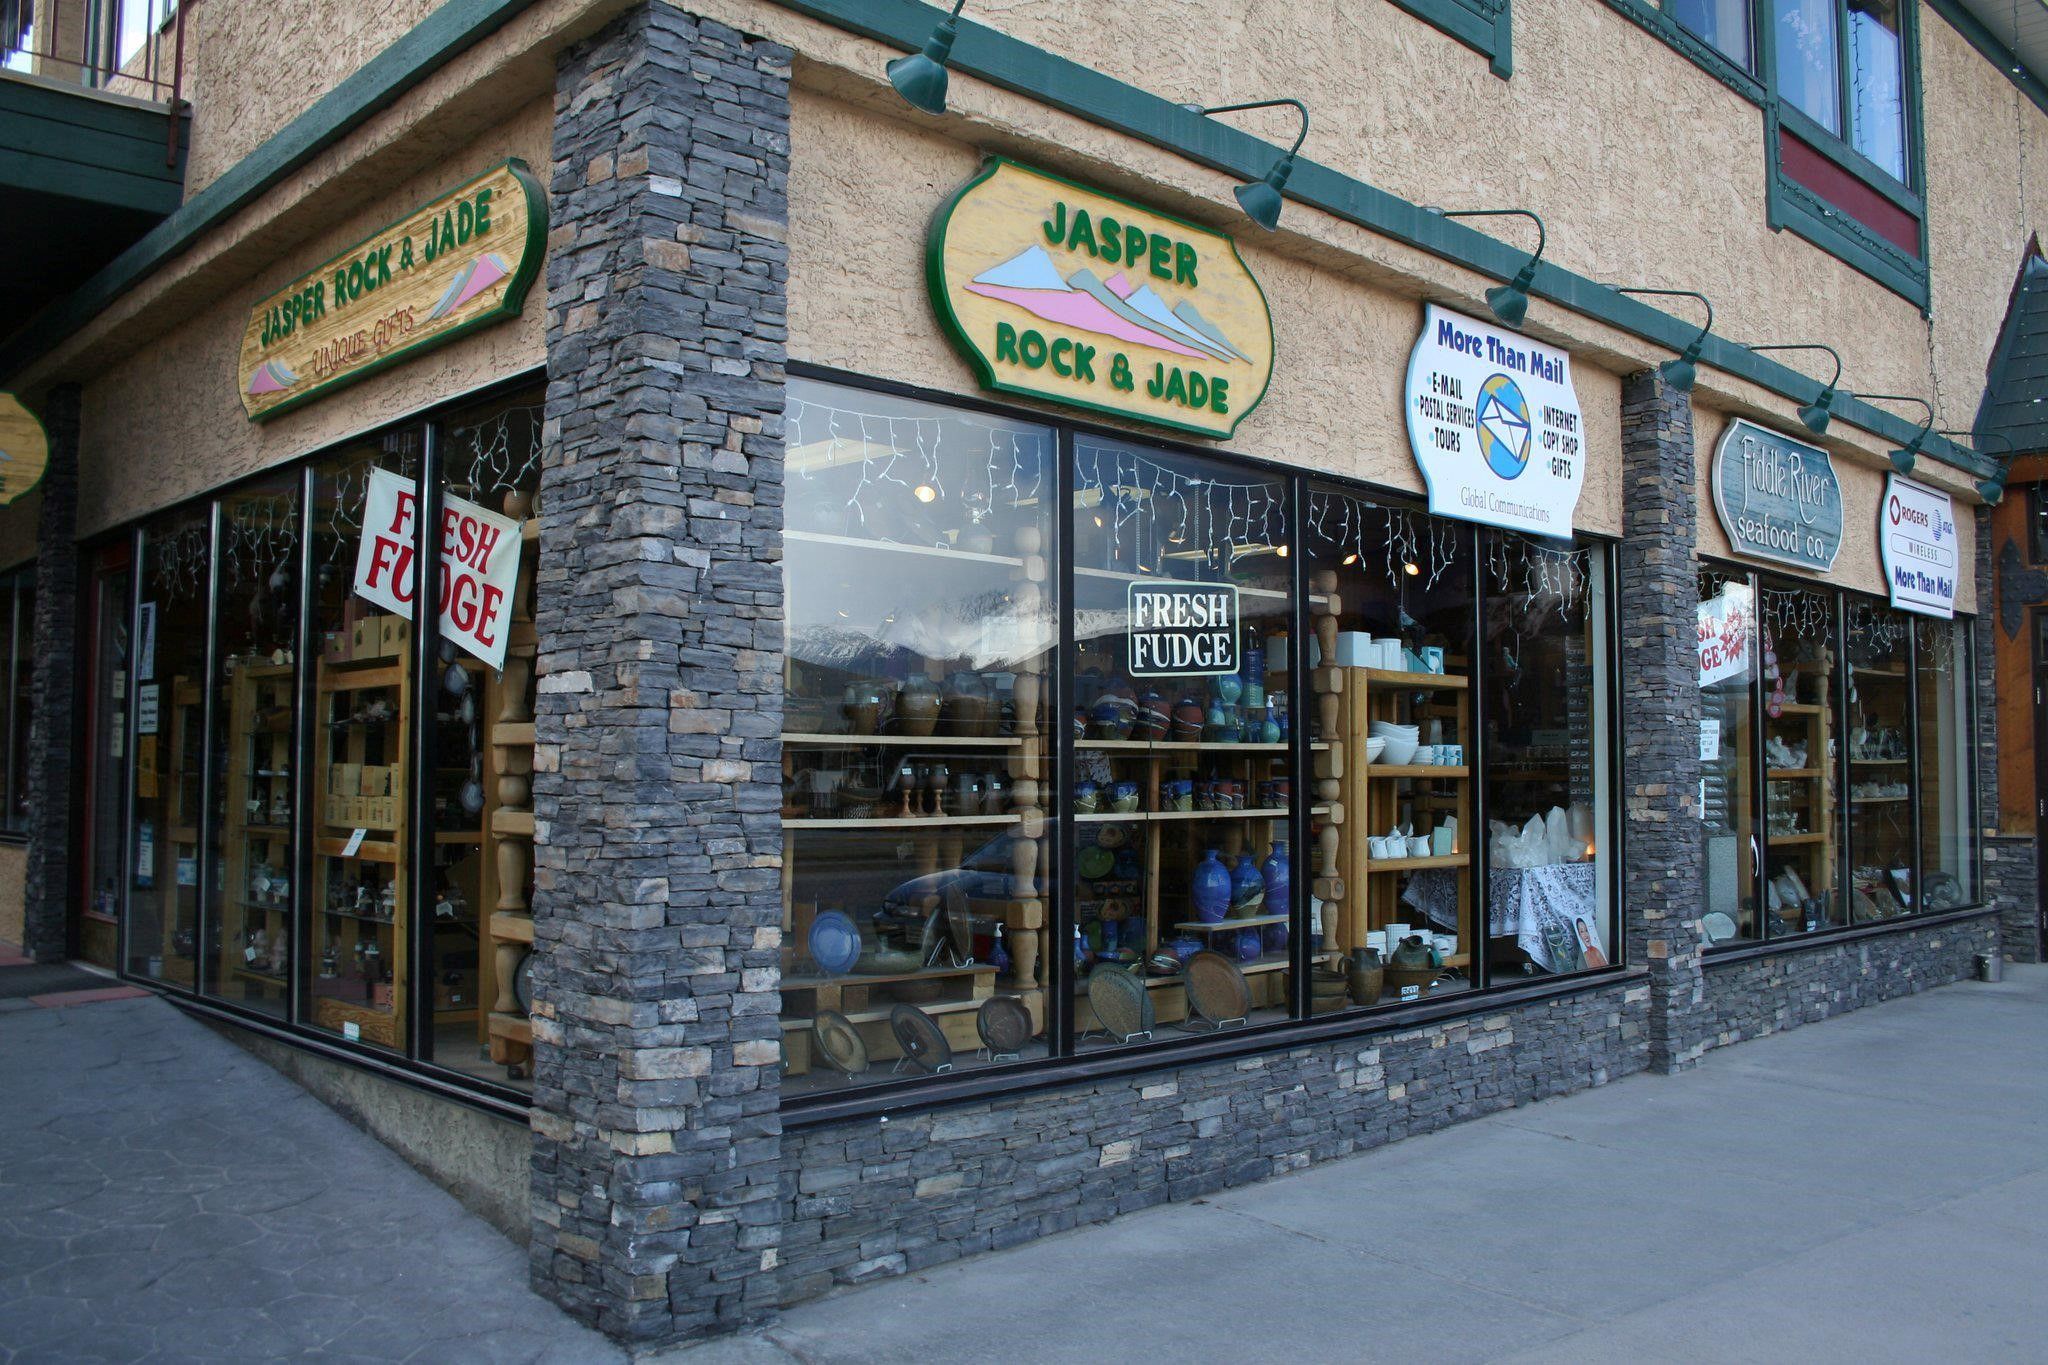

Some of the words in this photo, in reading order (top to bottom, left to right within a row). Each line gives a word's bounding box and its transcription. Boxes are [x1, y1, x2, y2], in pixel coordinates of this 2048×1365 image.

[1043, 201, 1199, 288] JASPER
[261, 280, 326, 347] JASPER
[334, 243, 393, 310] ROCK
[400, 236, 415, 270] &
[425, 188, 493, 262] JADE
[312, 328, 366, 376] UNIQUE
[373, 304, 415, 349] GIFTS
[1437, 318, 1483, 358] More
[1486, 335, 1526, 373] Than
[1530, 350, 1564, 386] Mail
[996, 321, 1096, 383] ROCK
[1109, 352, 1135, 392] &
[1147, 362, 1229, 415] JADE
[1432, 371, 1463, 400] E-MAIL
[1419, 395, 1445, 421] POSTAL
[1446, 402, 1474, 429] SERVICES
[1543, 405, 1577, 433] INTERNET
[1434, 426, 1461, 453] TOURS
[1542, 430, 1559, 452] COPY
[1562, 436, 1579, 457] SHOP
[1551, 456, 1571, 480] GIFTS
[1741, 435, 1787, 513] Fiddle
[1788, 452, 1829, 524] River
[1460, 486, 1487, 510] Global
[1488, 493, 1550, 524] Communications
[1902, 506, 1929, 527] ROGERS
[389, 490, 500, 575] FESH
[1737, 513, 1799, 553] seafood
[1908, 541, 1938, 561] WIRELESS
[1894, 565, 1915, 590] More
[1917, 571, 1936, 595] Than
[1937, 575, 1953, 599] Mail
[1134, 593, 1229, 628] FRESH
[1133, 633, 1232, 668] FUDGE
